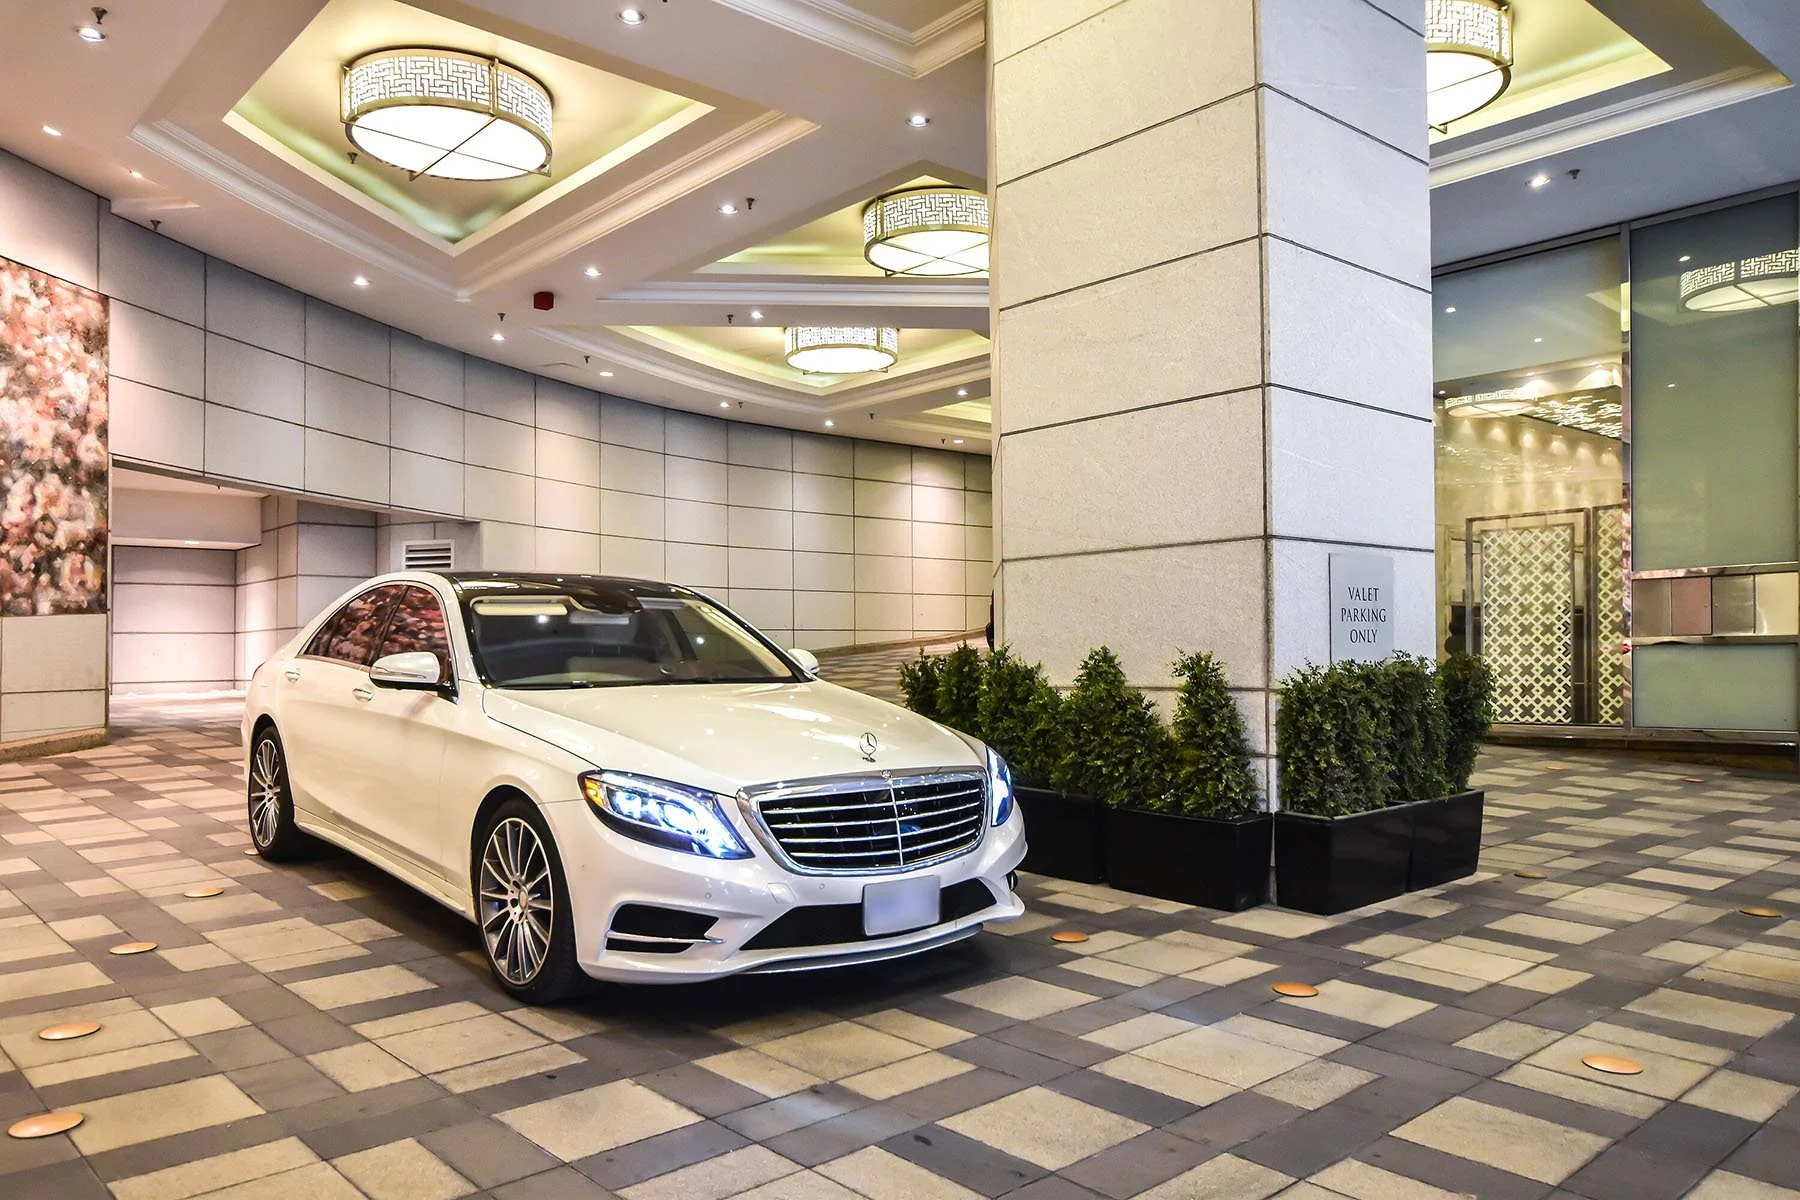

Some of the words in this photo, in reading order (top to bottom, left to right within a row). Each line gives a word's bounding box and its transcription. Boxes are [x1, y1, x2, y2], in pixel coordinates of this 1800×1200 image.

[1348, 587, 1379, 601] VALET
[1341, 608, 1386, 622] PARKING
[1350, 629, 1378, 643] ONLY
